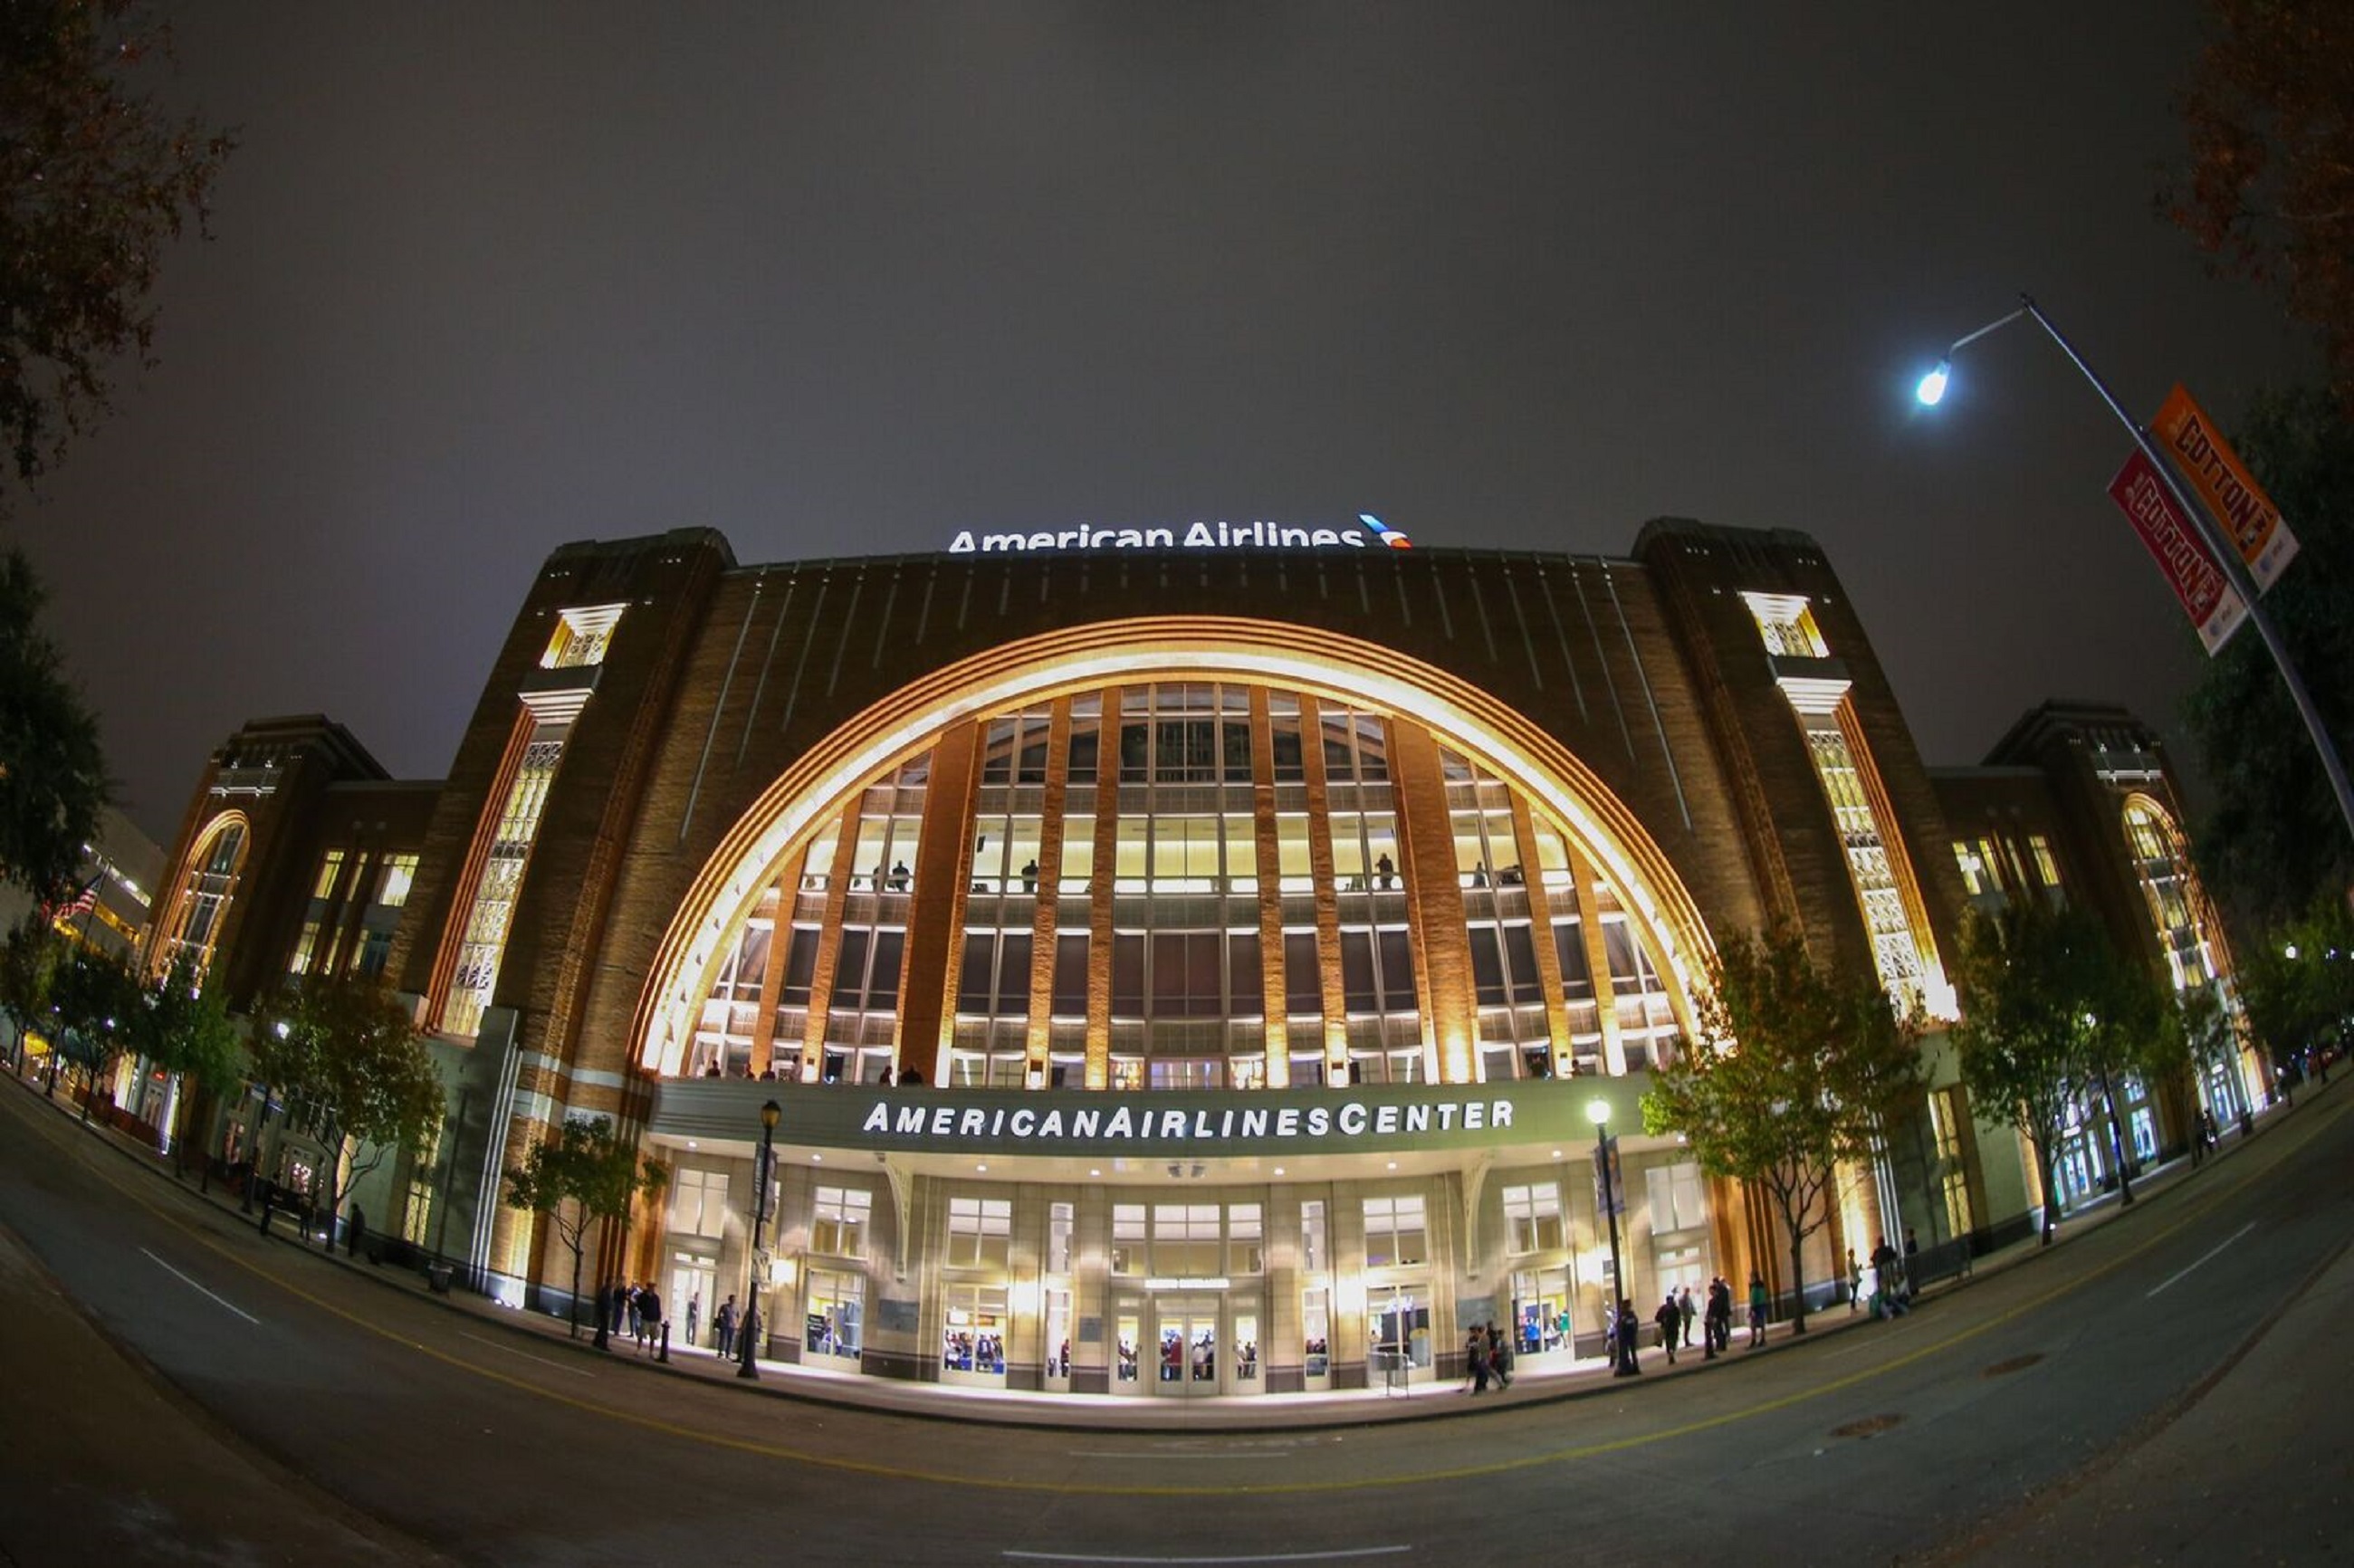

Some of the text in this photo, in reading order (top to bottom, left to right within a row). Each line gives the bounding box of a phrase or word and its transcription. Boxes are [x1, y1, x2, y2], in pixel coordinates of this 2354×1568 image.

[949, 521, 1364, 553] American Airlines
[2175, 412, 2263, 537] COTTON
[2129, 476, 2215, 603] COTTON
